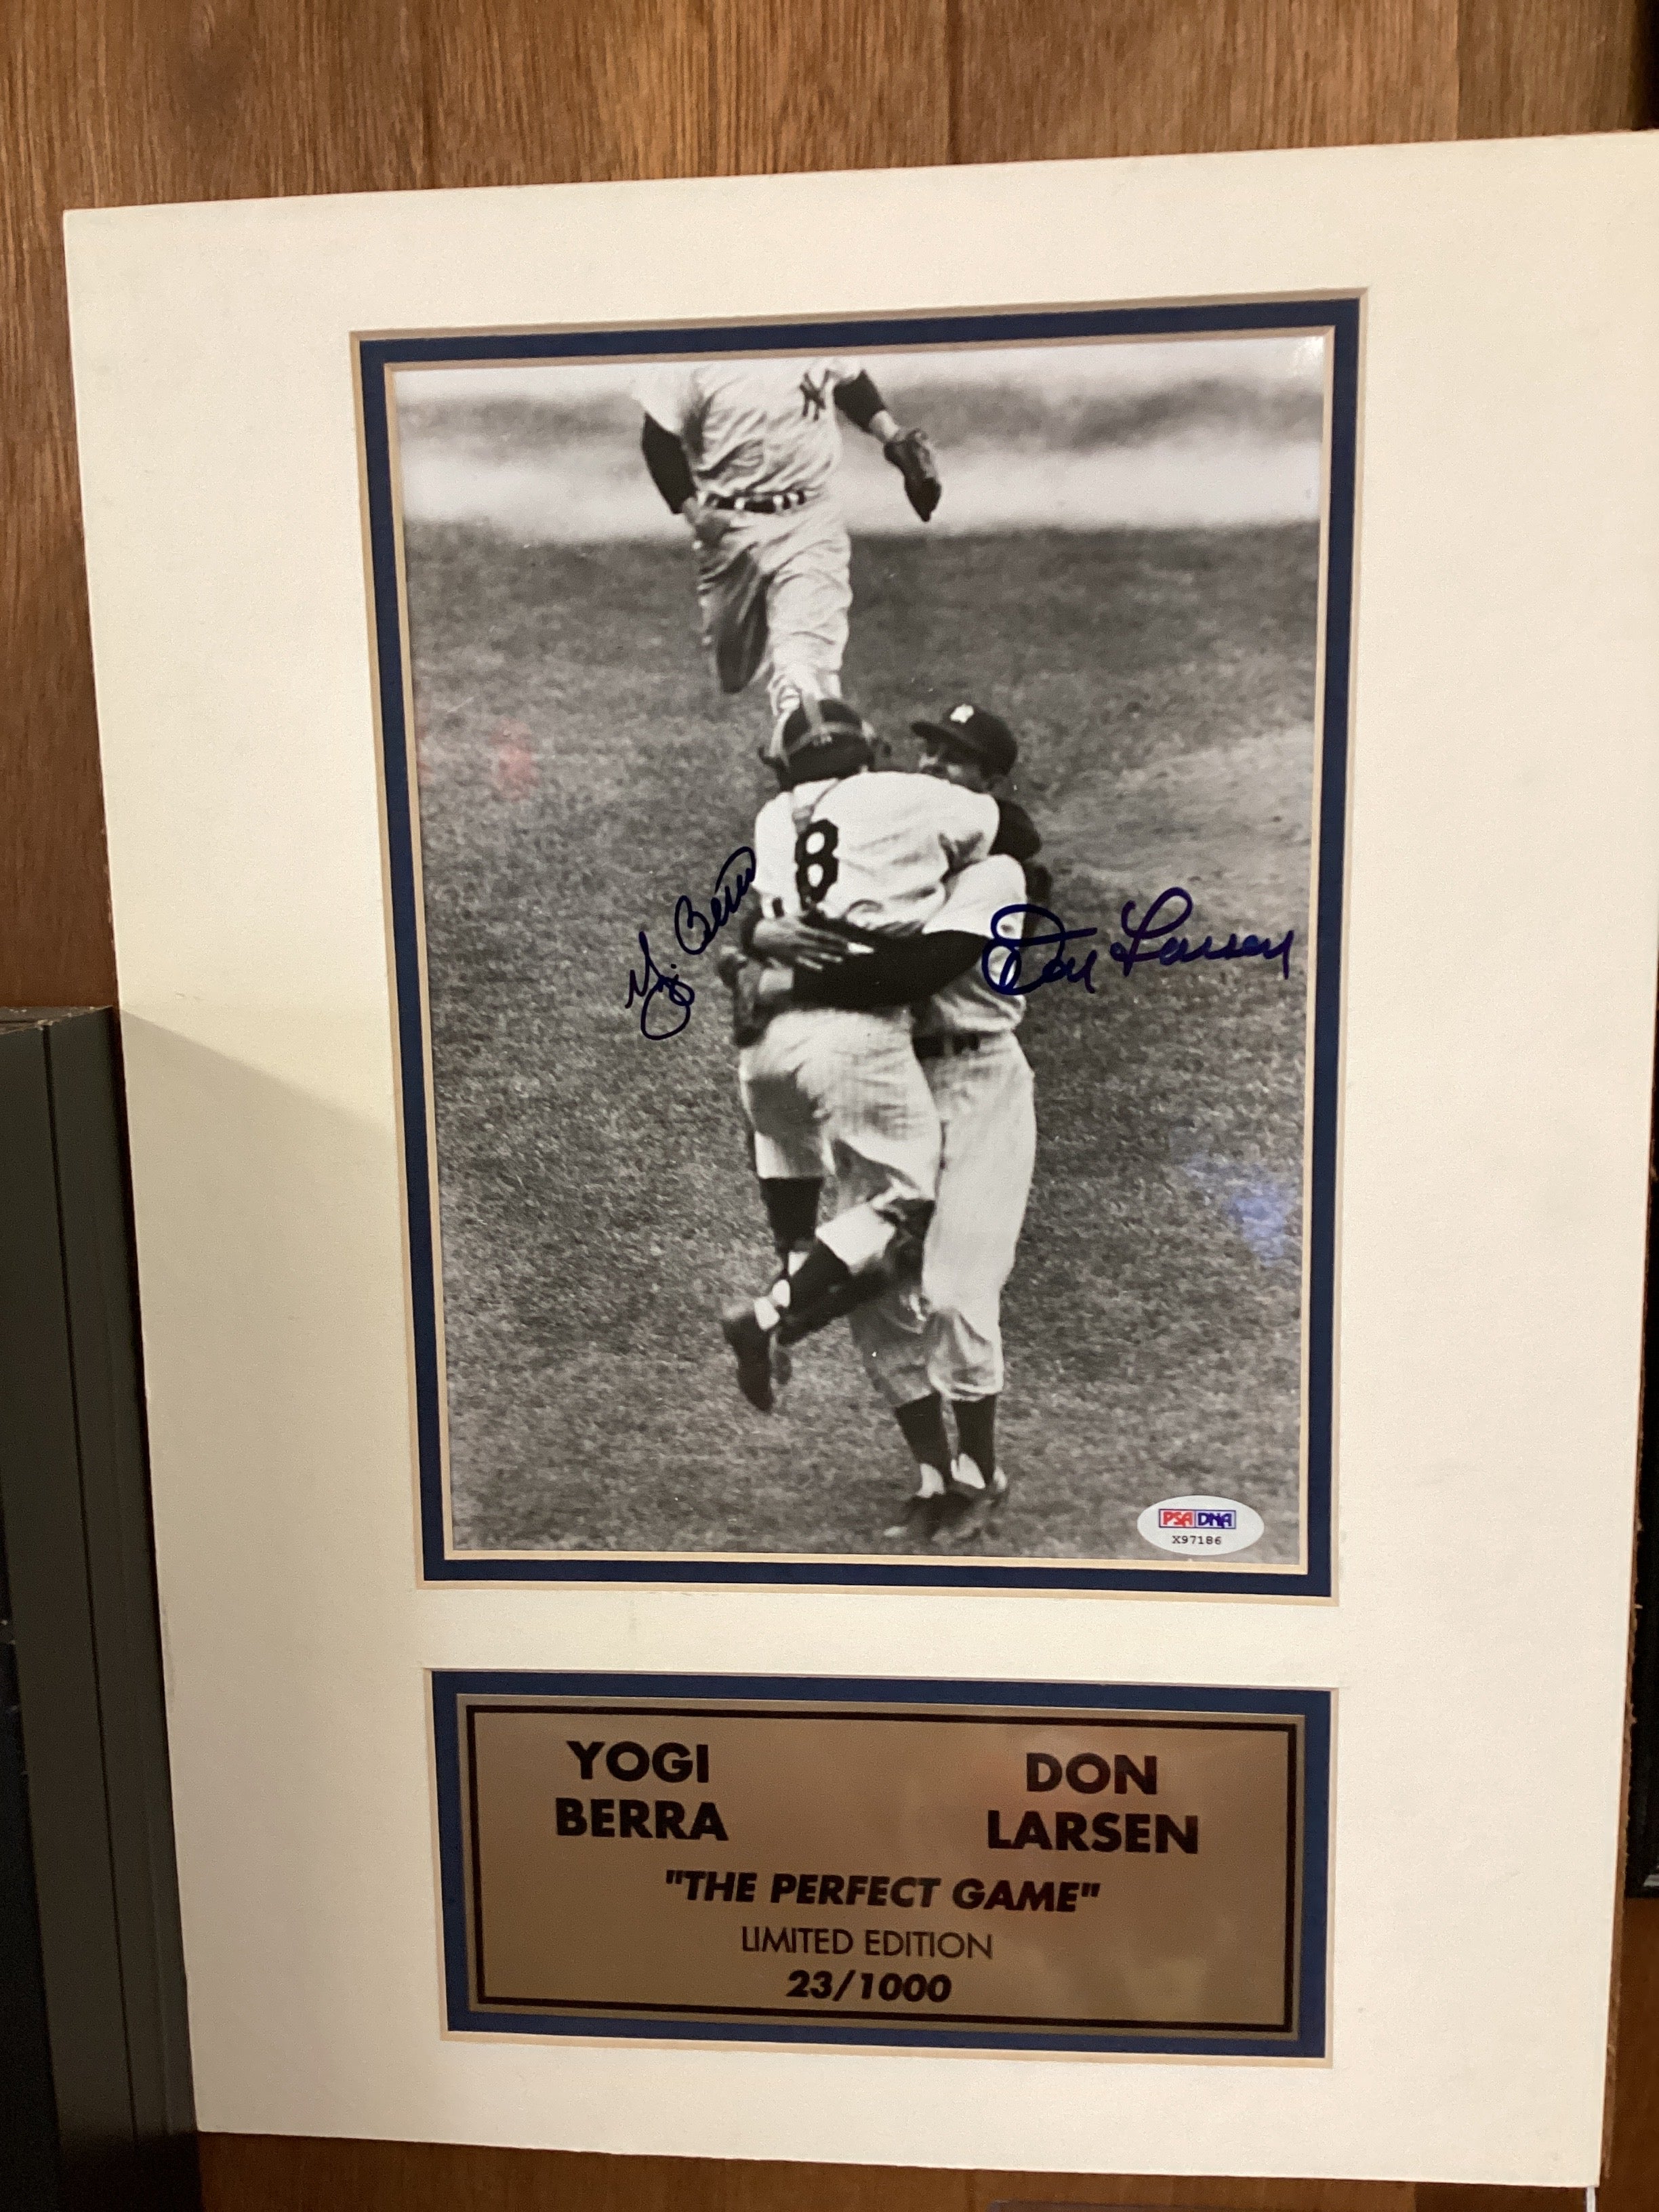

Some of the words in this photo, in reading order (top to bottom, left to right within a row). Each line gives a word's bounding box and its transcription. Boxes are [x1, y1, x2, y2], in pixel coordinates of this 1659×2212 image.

[795, 819, 840, 904] 8
[1162, 1511, 1193, 1526] PSA
[1197, 1513, 1232, 1529] DNA
[1172, 1535, 1222, 1544] X97186
[567, 1740, 710, 1783] YOGI
[1025, 1753, 1158, 1795] DON
[556, 1799, 729, 1841] BERRA
[987, 1810, 1198, 1854] LARSEN
[665, 1870, 756, 1902] "THE
[770, 1875, 941, 1908] PERFECT
[952, 1878, 1101, 1912] GAME"
[741, 1927, 854, 1955] LIMITED
[865, 1931, 993, 1959] EDITION
[787, 1969, 951, 2003] 23/1000
